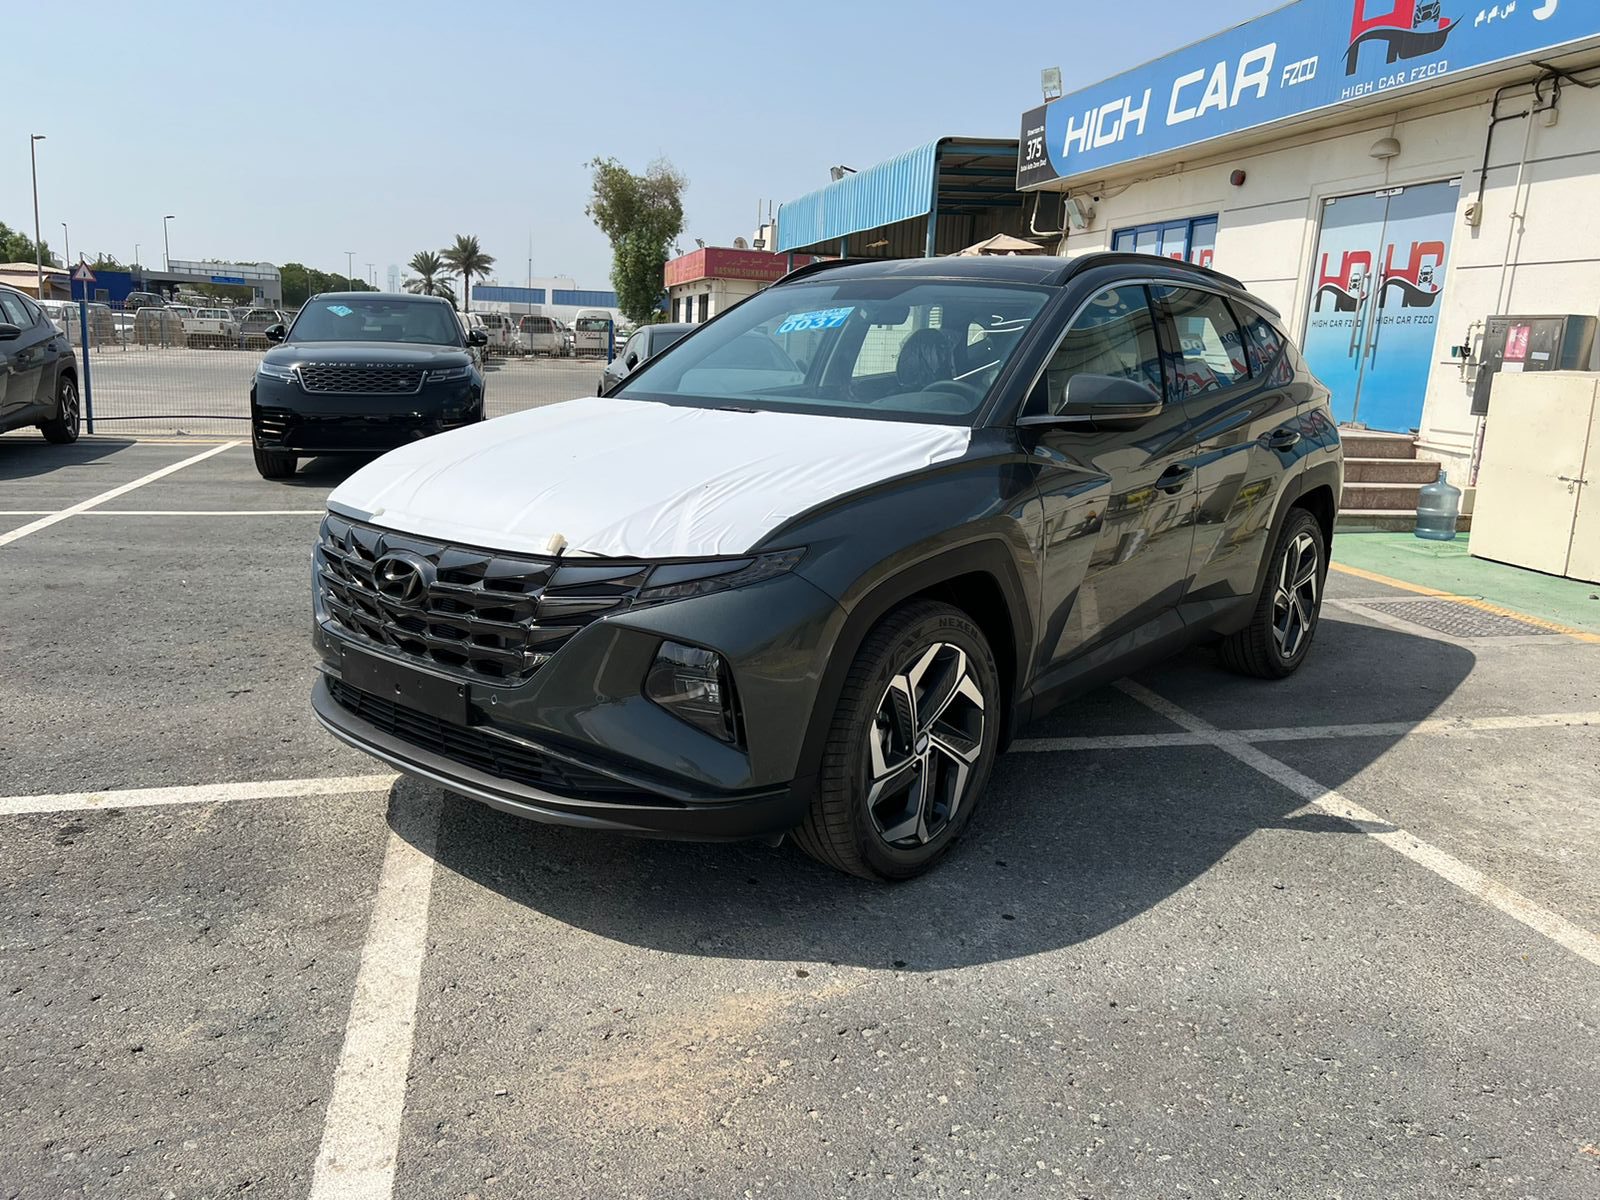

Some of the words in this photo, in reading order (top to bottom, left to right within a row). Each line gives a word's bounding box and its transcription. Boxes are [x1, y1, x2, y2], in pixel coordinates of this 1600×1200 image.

[1341, 81, 1373, 99] HIGH
[1378, 71, 1406, 89] CAR
[1410, 60, 1448, 80] FZCO
[1062, 88, 1152, 158] HIGH
[1166, 42, 1277, 126] CAR
[1281, 55, 1319, 88] FZCO
[1026, 136, 1043, 160] 375
[780, 315, 842, 333] 0037
[1311, 320, 1328, 328] HIGH
[1376, 316, 1394, 325] HIGH
[1396, 316, 1412, 324] CAR
[1413, 315, 1435, 324] FZCO
[939, 617, 979, 639] NEXEN
